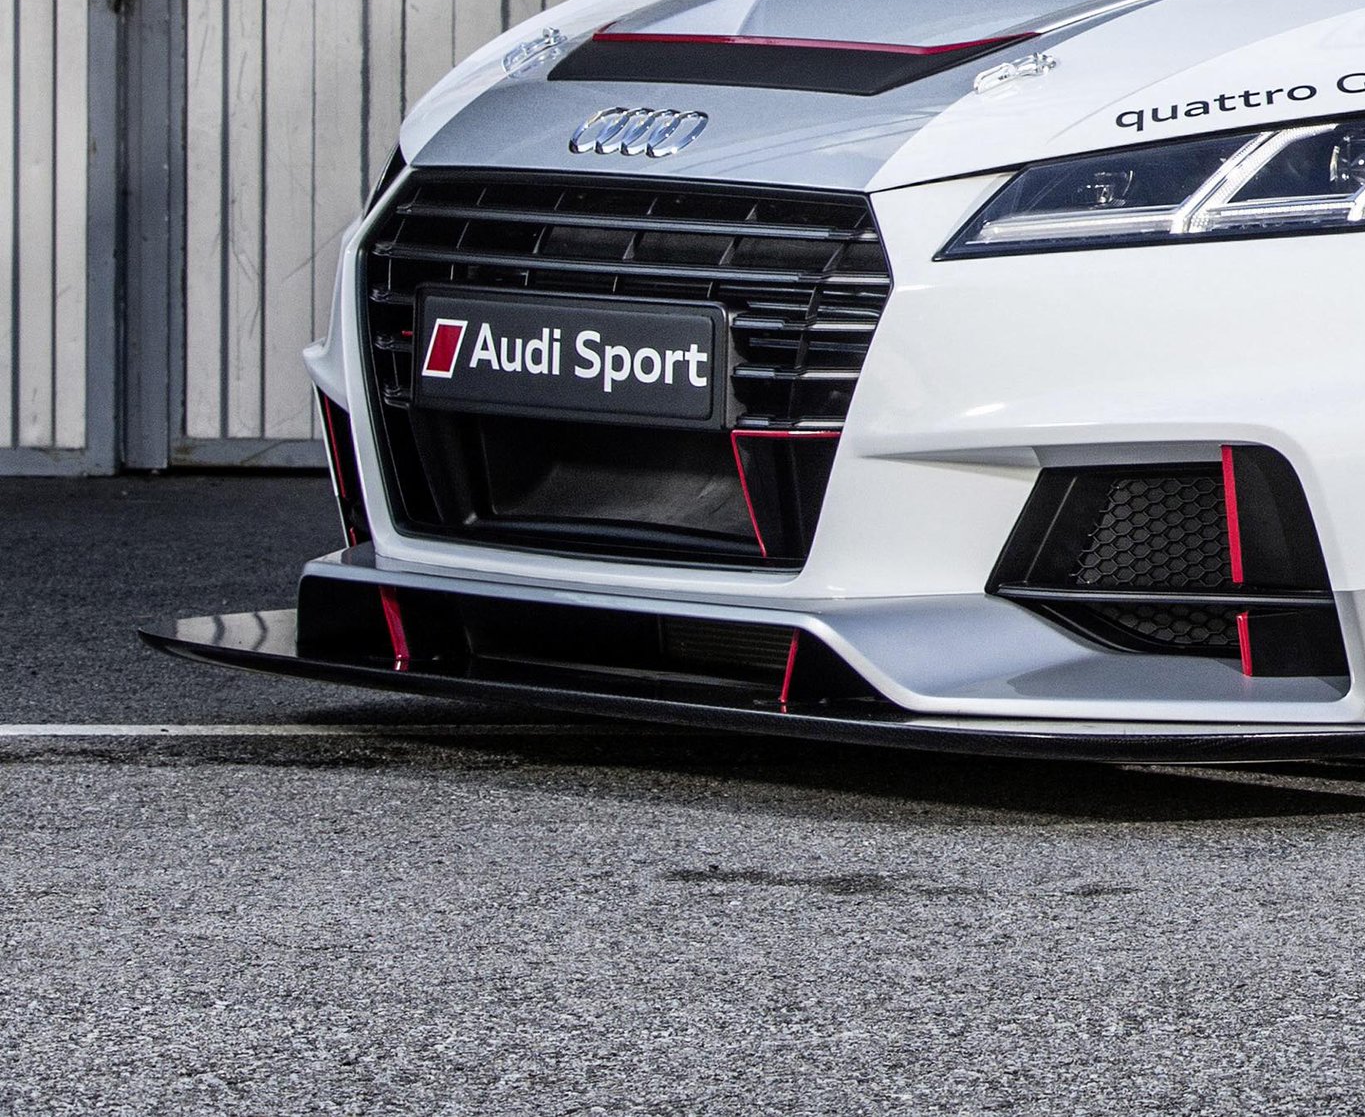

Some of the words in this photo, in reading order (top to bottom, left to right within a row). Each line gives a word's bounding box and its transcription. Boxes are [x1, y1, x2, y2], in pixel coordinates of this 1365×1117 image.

[1115, 85, 1318, 132] quattro
[469, 322, 561, 376] Audi
[574, 330, 708, 393] Sport
